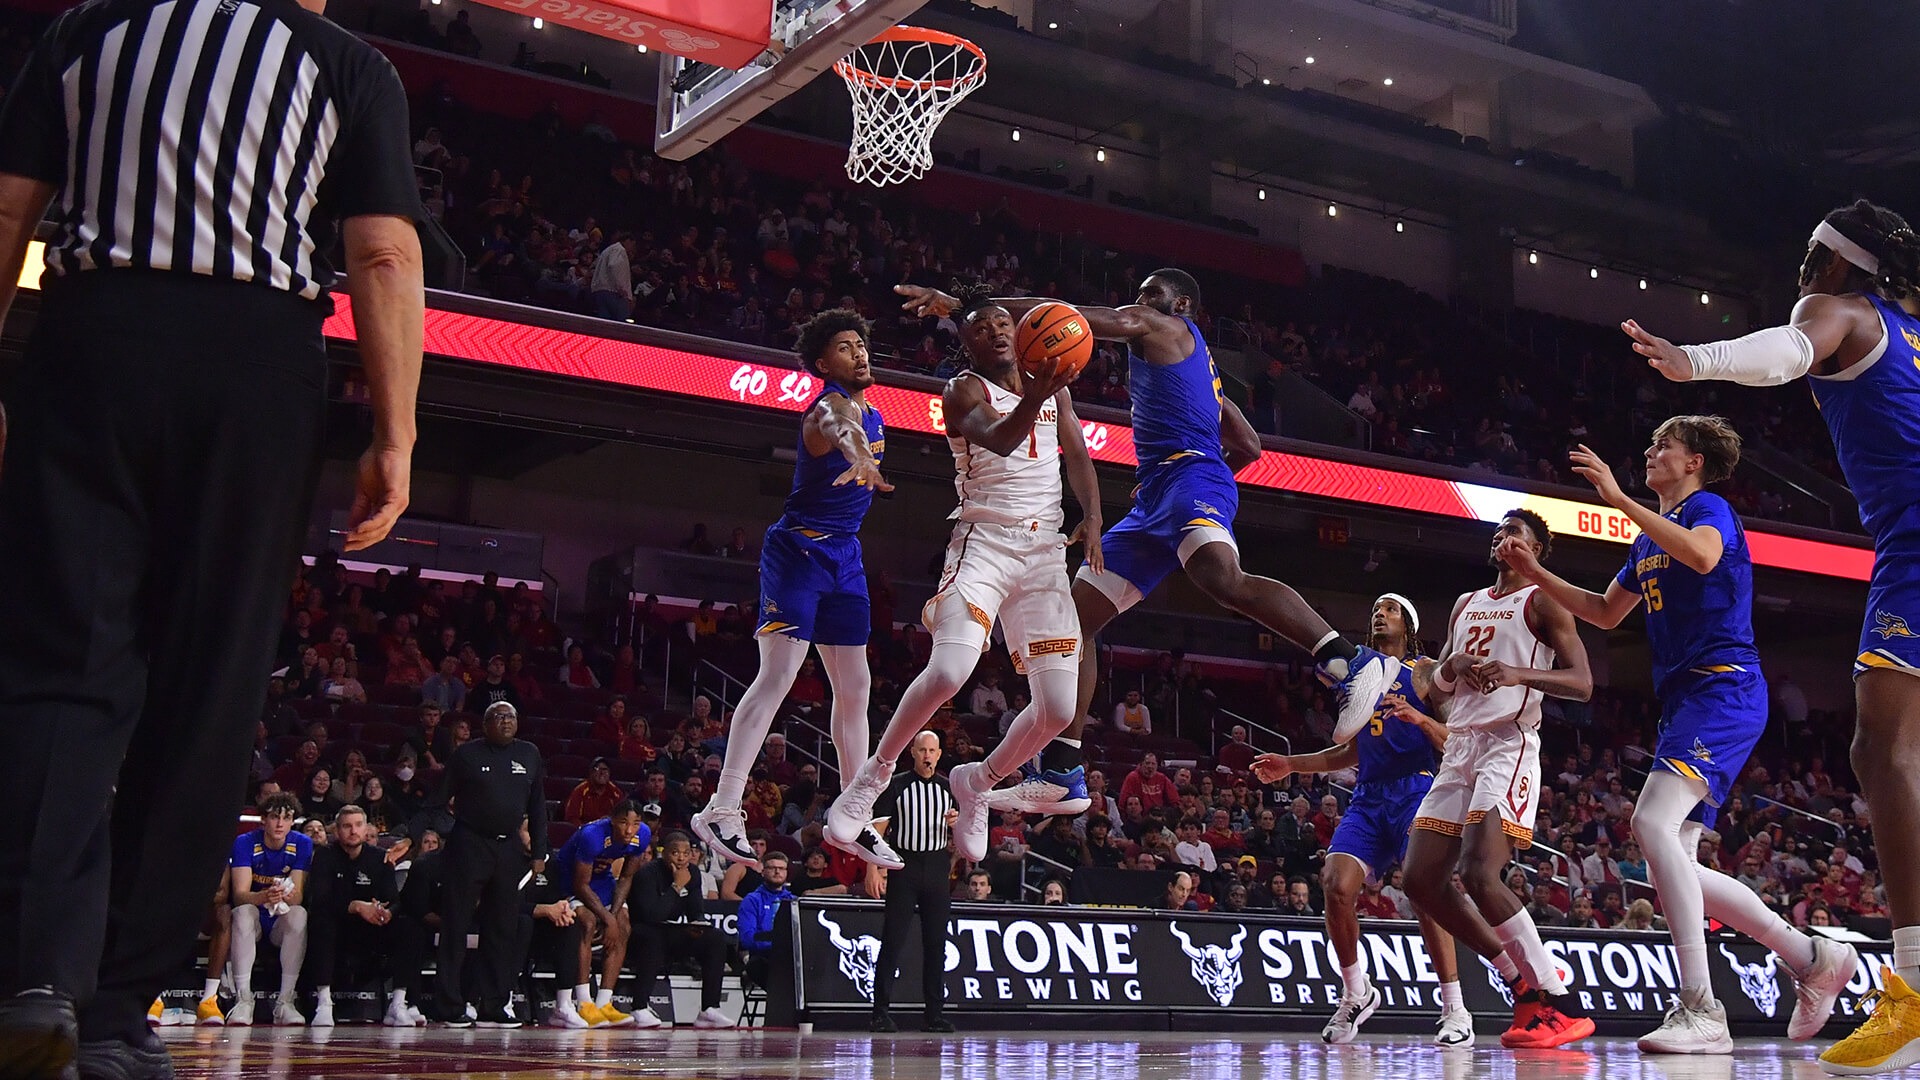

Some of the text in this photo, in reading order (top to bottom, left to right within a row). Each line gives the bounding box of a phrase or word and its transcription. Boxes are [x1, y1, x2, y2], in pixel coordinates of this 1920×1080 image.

[729, 364, 812, 402] GO SC
[1578, 510, 1631, 539] GO SC
[1464, 610, 1515, 621] TROJANS
[1465, 625, 1496, 657] 22
[1258, 928, 1441, 983] STONE
[1543, 940, 1682, 989] STON
[944, 976, 1143, 1001] REWING
[1269, 982, 1445, 1007] BREIN
[1578, 990, 1681, 1012] REWI
